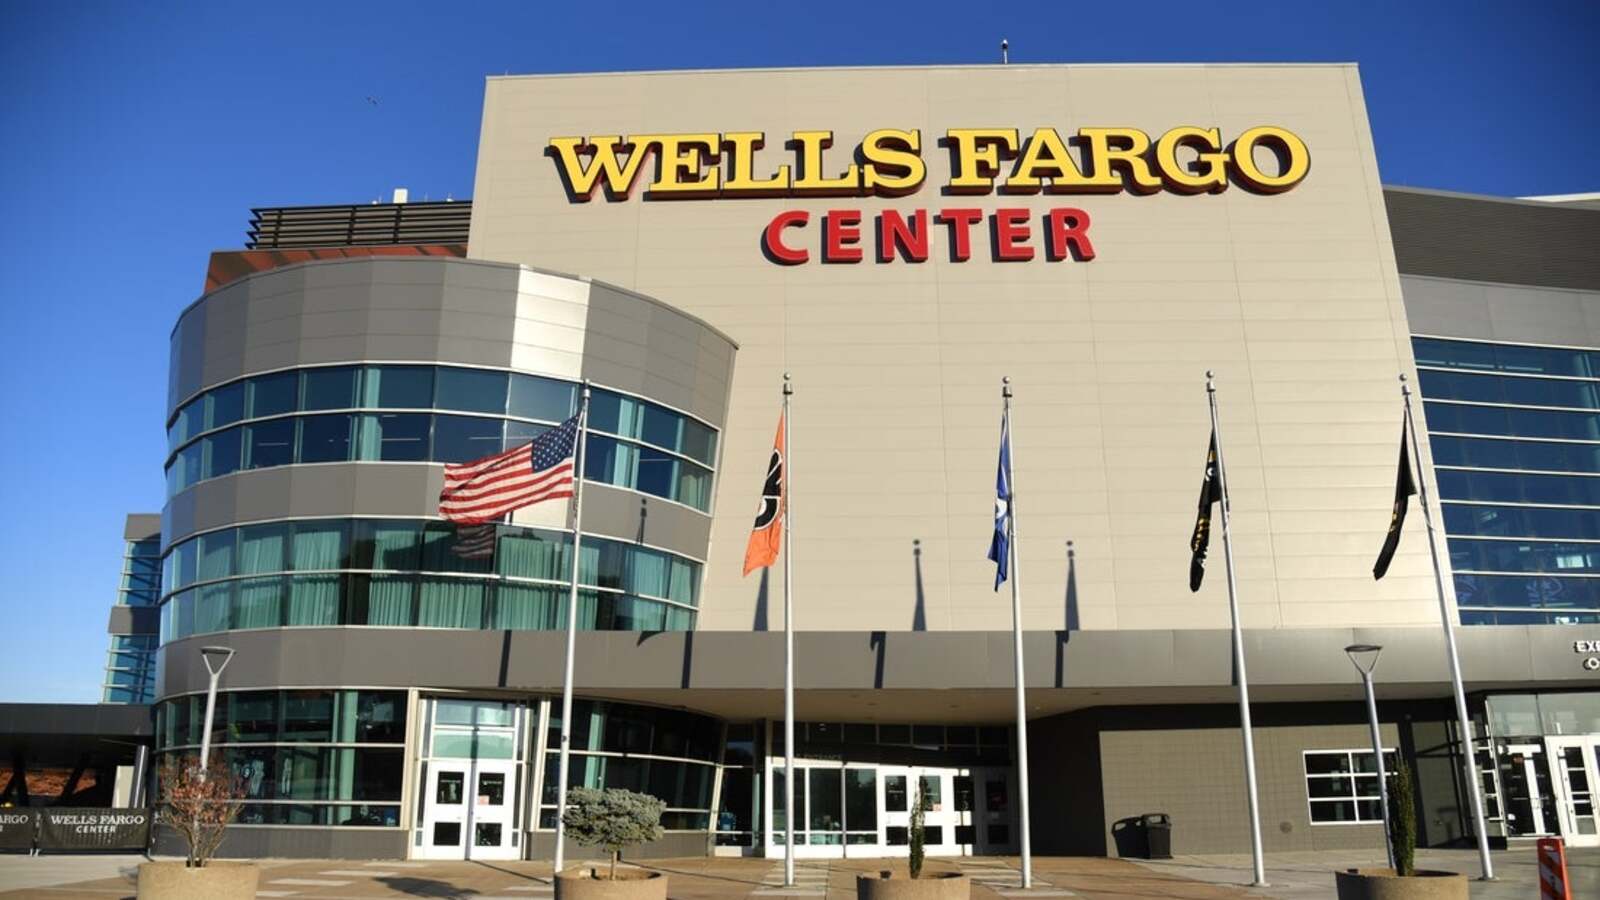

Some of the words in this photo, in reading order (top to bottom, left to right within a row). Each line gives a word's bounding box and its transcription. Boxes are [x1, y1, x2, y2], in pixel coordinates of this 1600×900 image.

[548, 128, 927, 198] WELLS
[946, 125, 1311, 193] FARGO
[764, 208, 1095, 263] CENTER
[50, 815, 97, 825] WELLS
[100, 815, 144, 825] FARGO
[76, 825, 116, 834] CENTER
